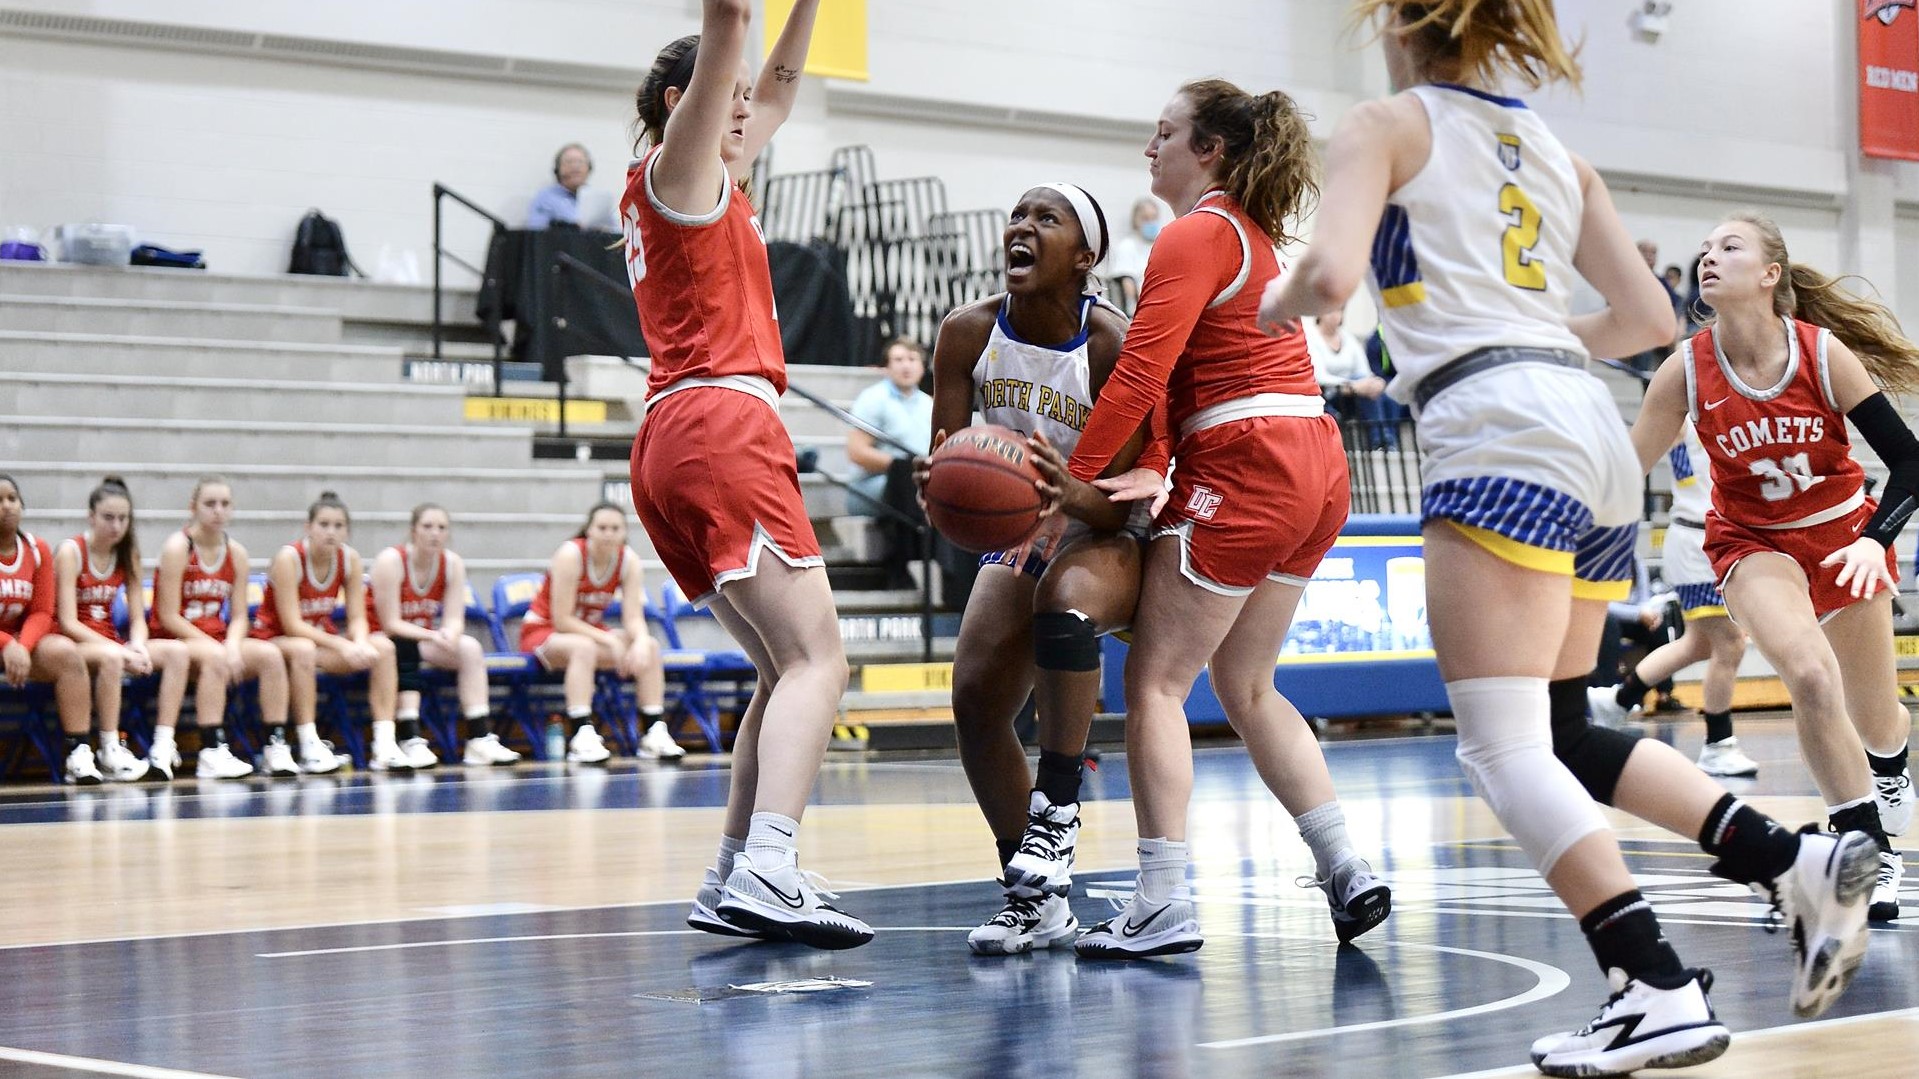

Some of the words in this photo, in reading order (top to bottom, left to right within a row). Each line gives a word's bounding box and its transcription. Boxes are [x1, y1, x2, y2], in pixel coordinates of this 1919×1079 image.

[1498, 182, 1547, 292] 2
[981, 379, 1033, 412] ORTH
[1716, 416, 1824, 458] COMETS
